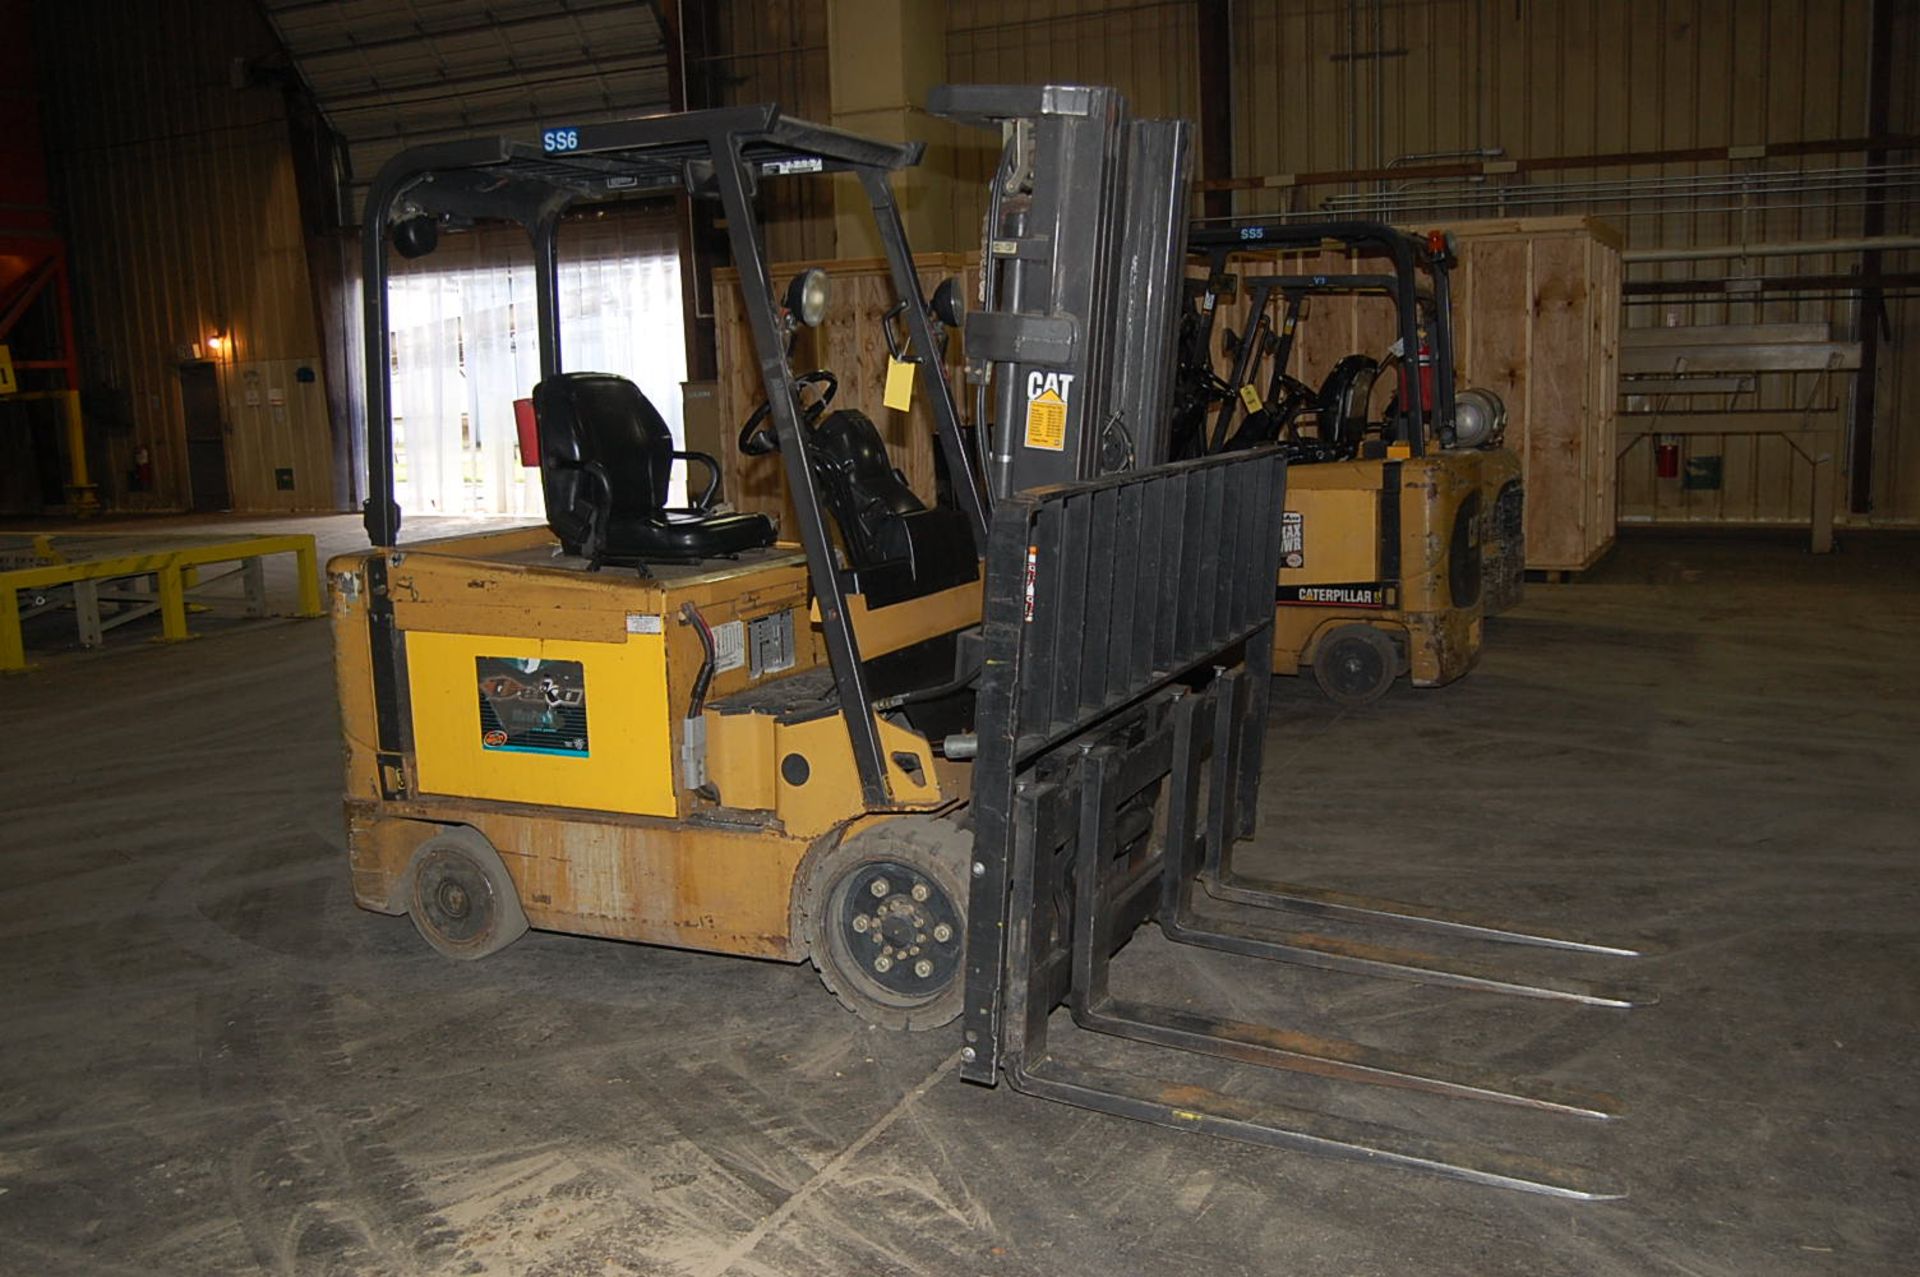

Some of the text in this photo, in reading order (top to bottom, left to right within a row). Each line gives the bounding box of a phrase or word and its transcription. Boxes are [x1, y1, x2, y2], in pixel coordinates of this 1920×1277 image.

[544, 131, 578, 151] SS6
[1240, 227, 1264, 239] SS5
[1027, 371, 1075, 402] CAT
[1298, 587, 1372, 603] CATERPILLAR
